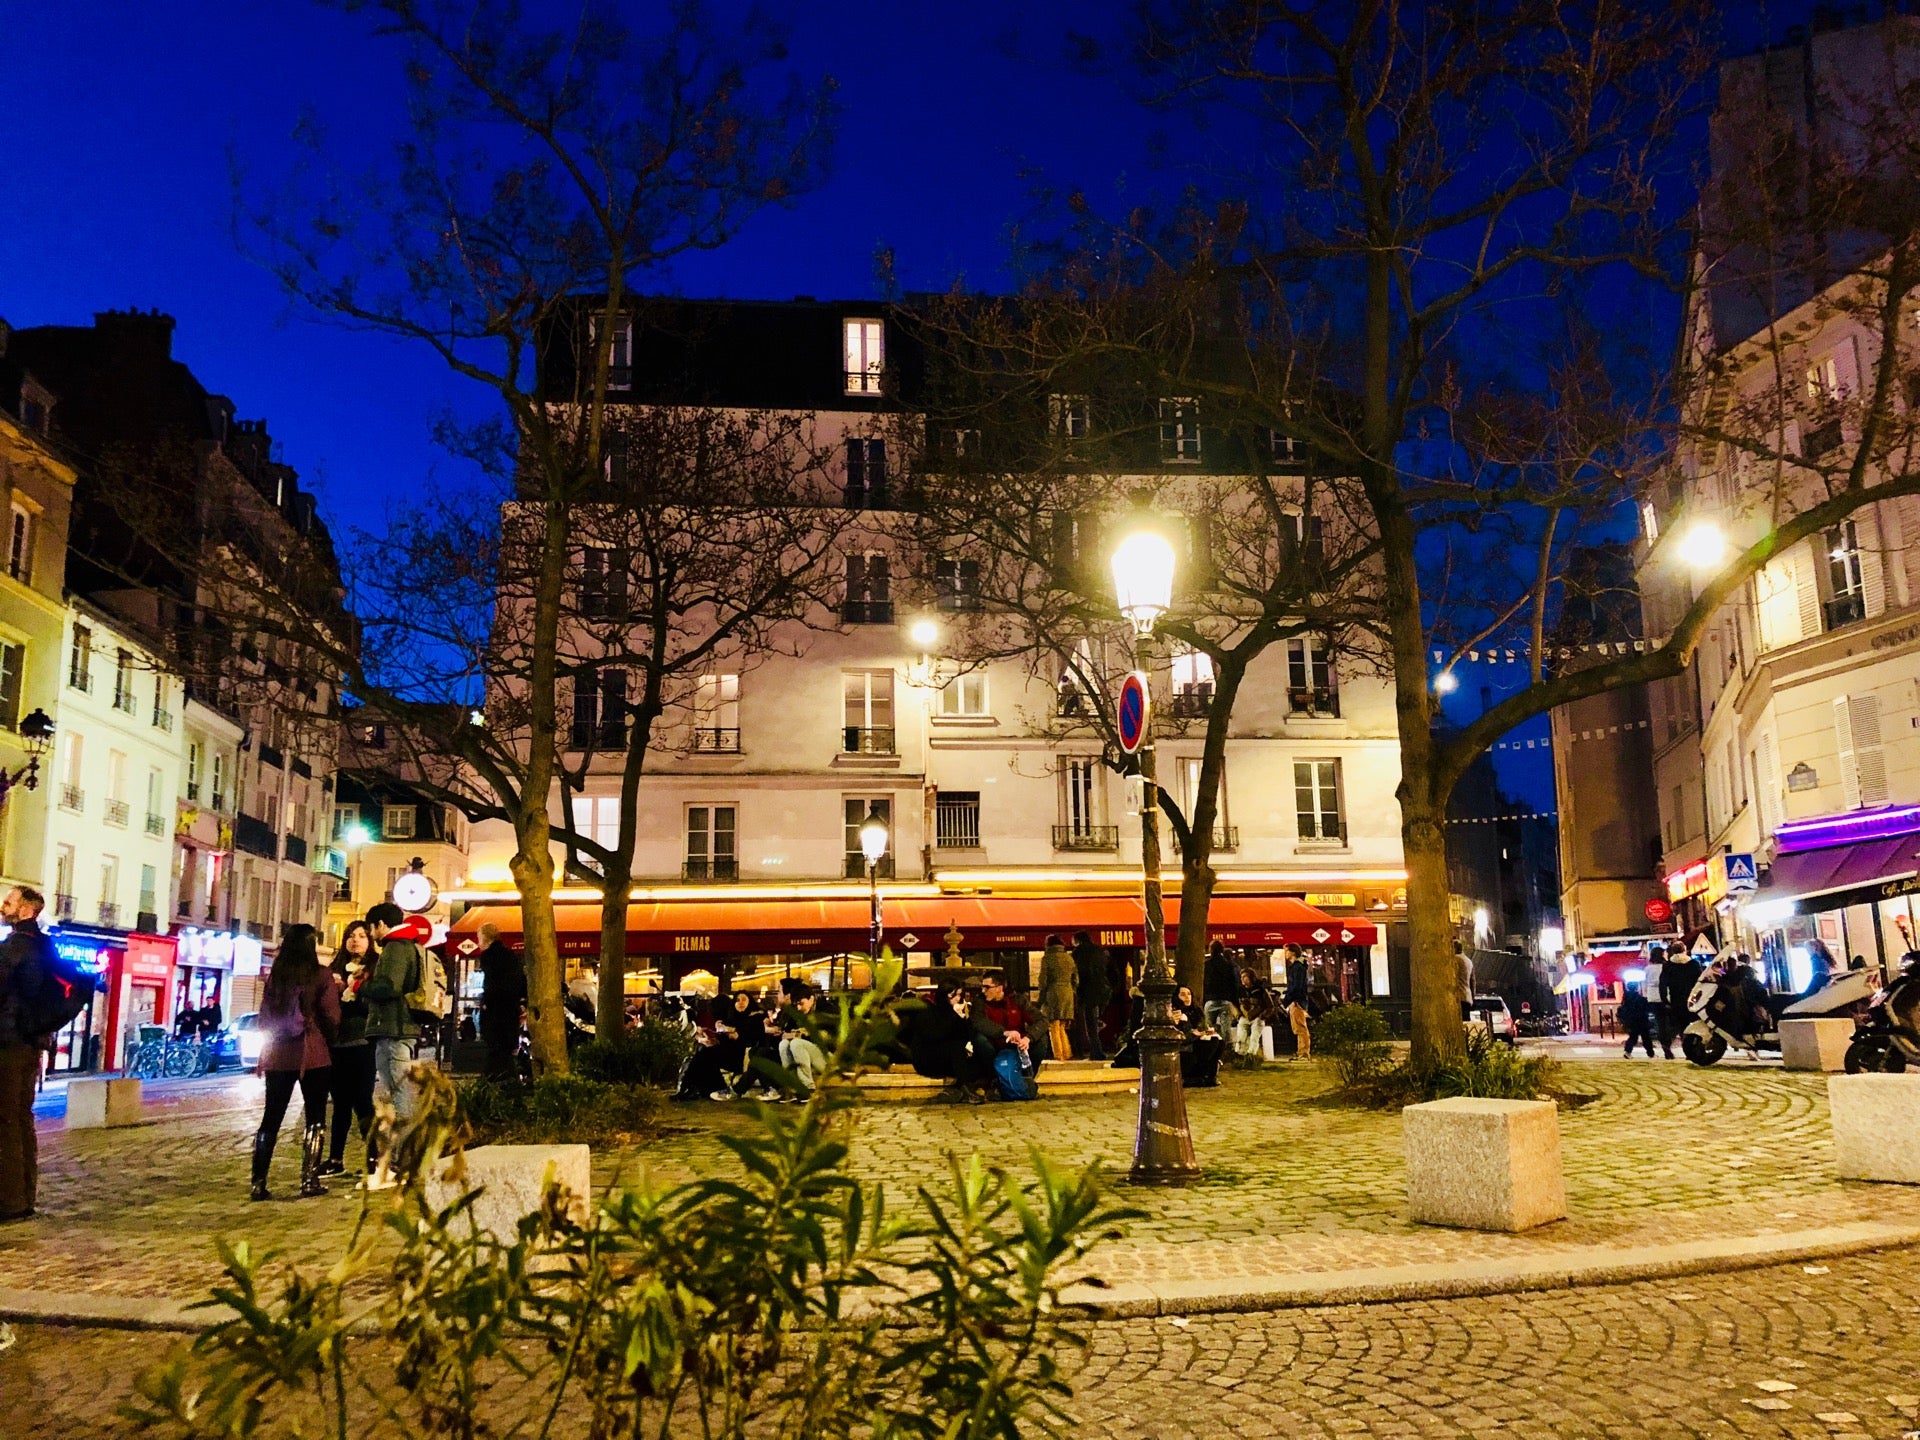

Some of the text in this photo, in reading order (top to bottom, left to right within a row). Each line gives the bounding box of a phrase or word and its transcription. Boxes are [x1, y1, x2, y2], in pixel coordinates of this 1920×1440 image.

[1316, 894, 1343, 905] SALON
[675, 936, 711, 951] DELMAS
[1101, 931, 1134, 945] DELMAS
